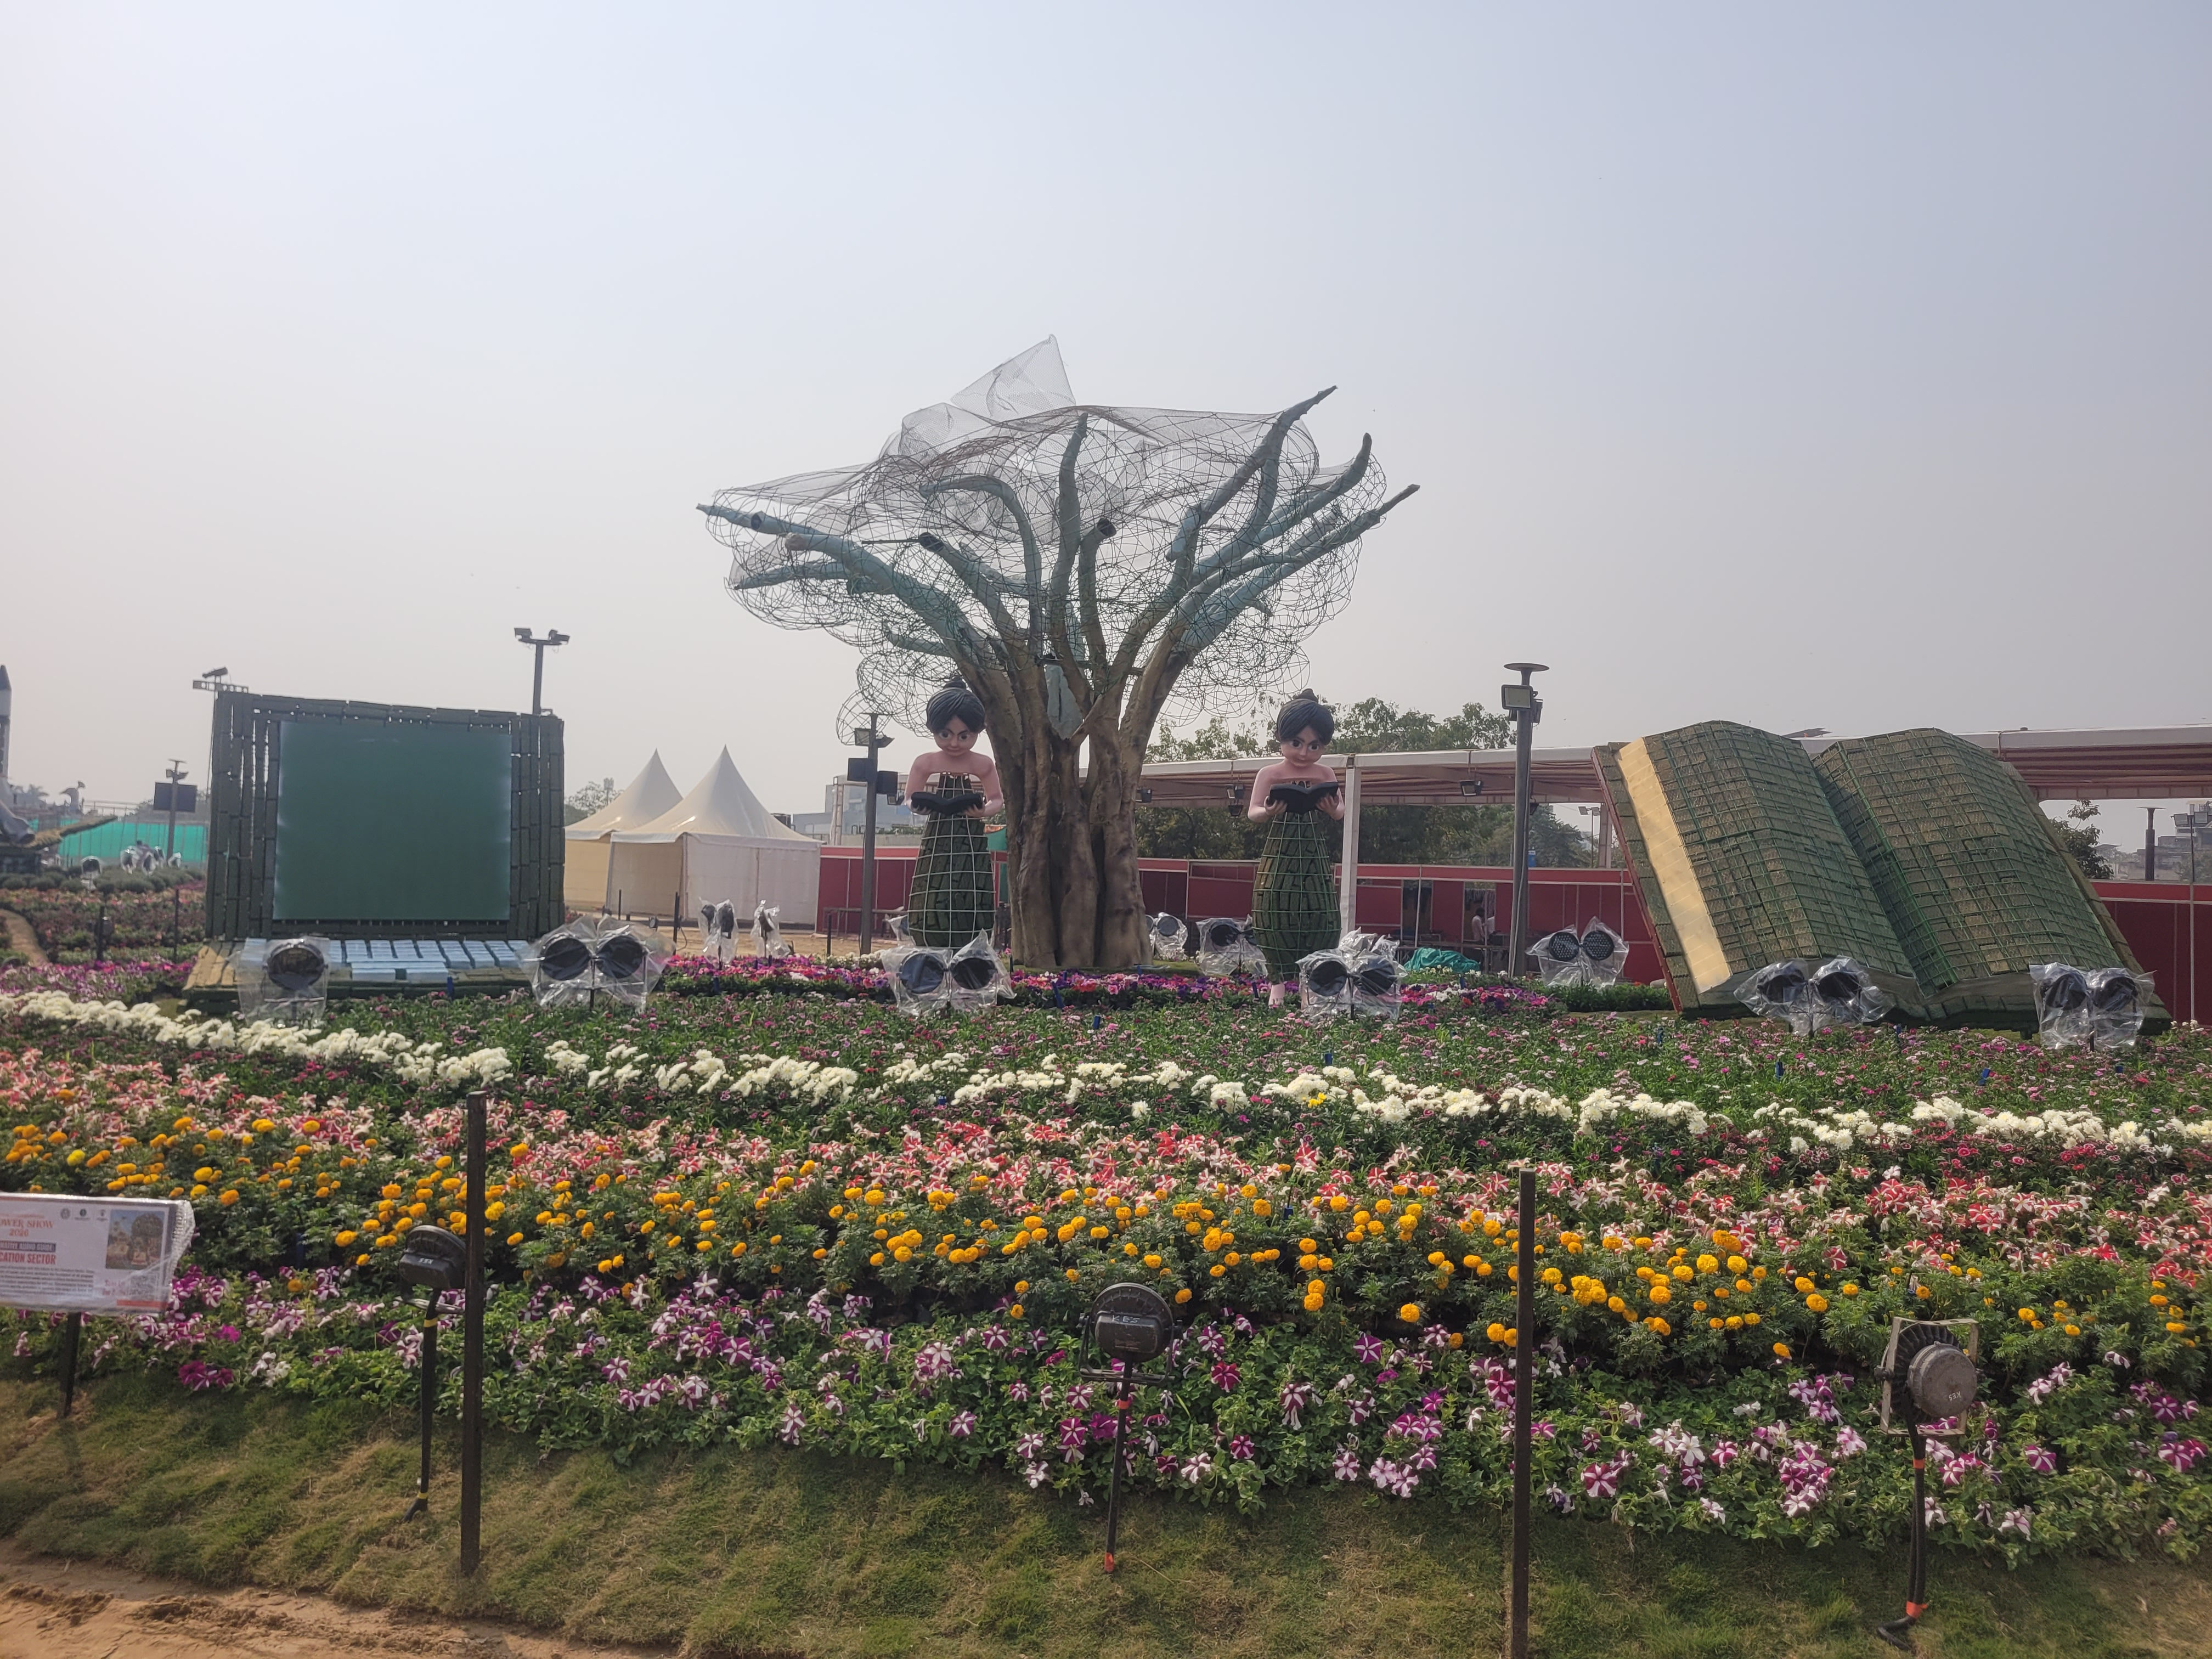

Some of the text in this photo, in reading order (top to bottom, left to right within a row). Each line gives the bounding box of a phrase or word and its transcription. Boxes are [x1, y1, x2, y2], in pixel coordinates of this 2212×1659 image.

[27, 1220, 53, 1228] SHOW
[9, 1228, 29, 1237] 2026
[27, 1253, 56, 1265] SECTOR
[1111, 1314, 1141, 1323] KES
[1948, 1391, 1961, 1401] KES
